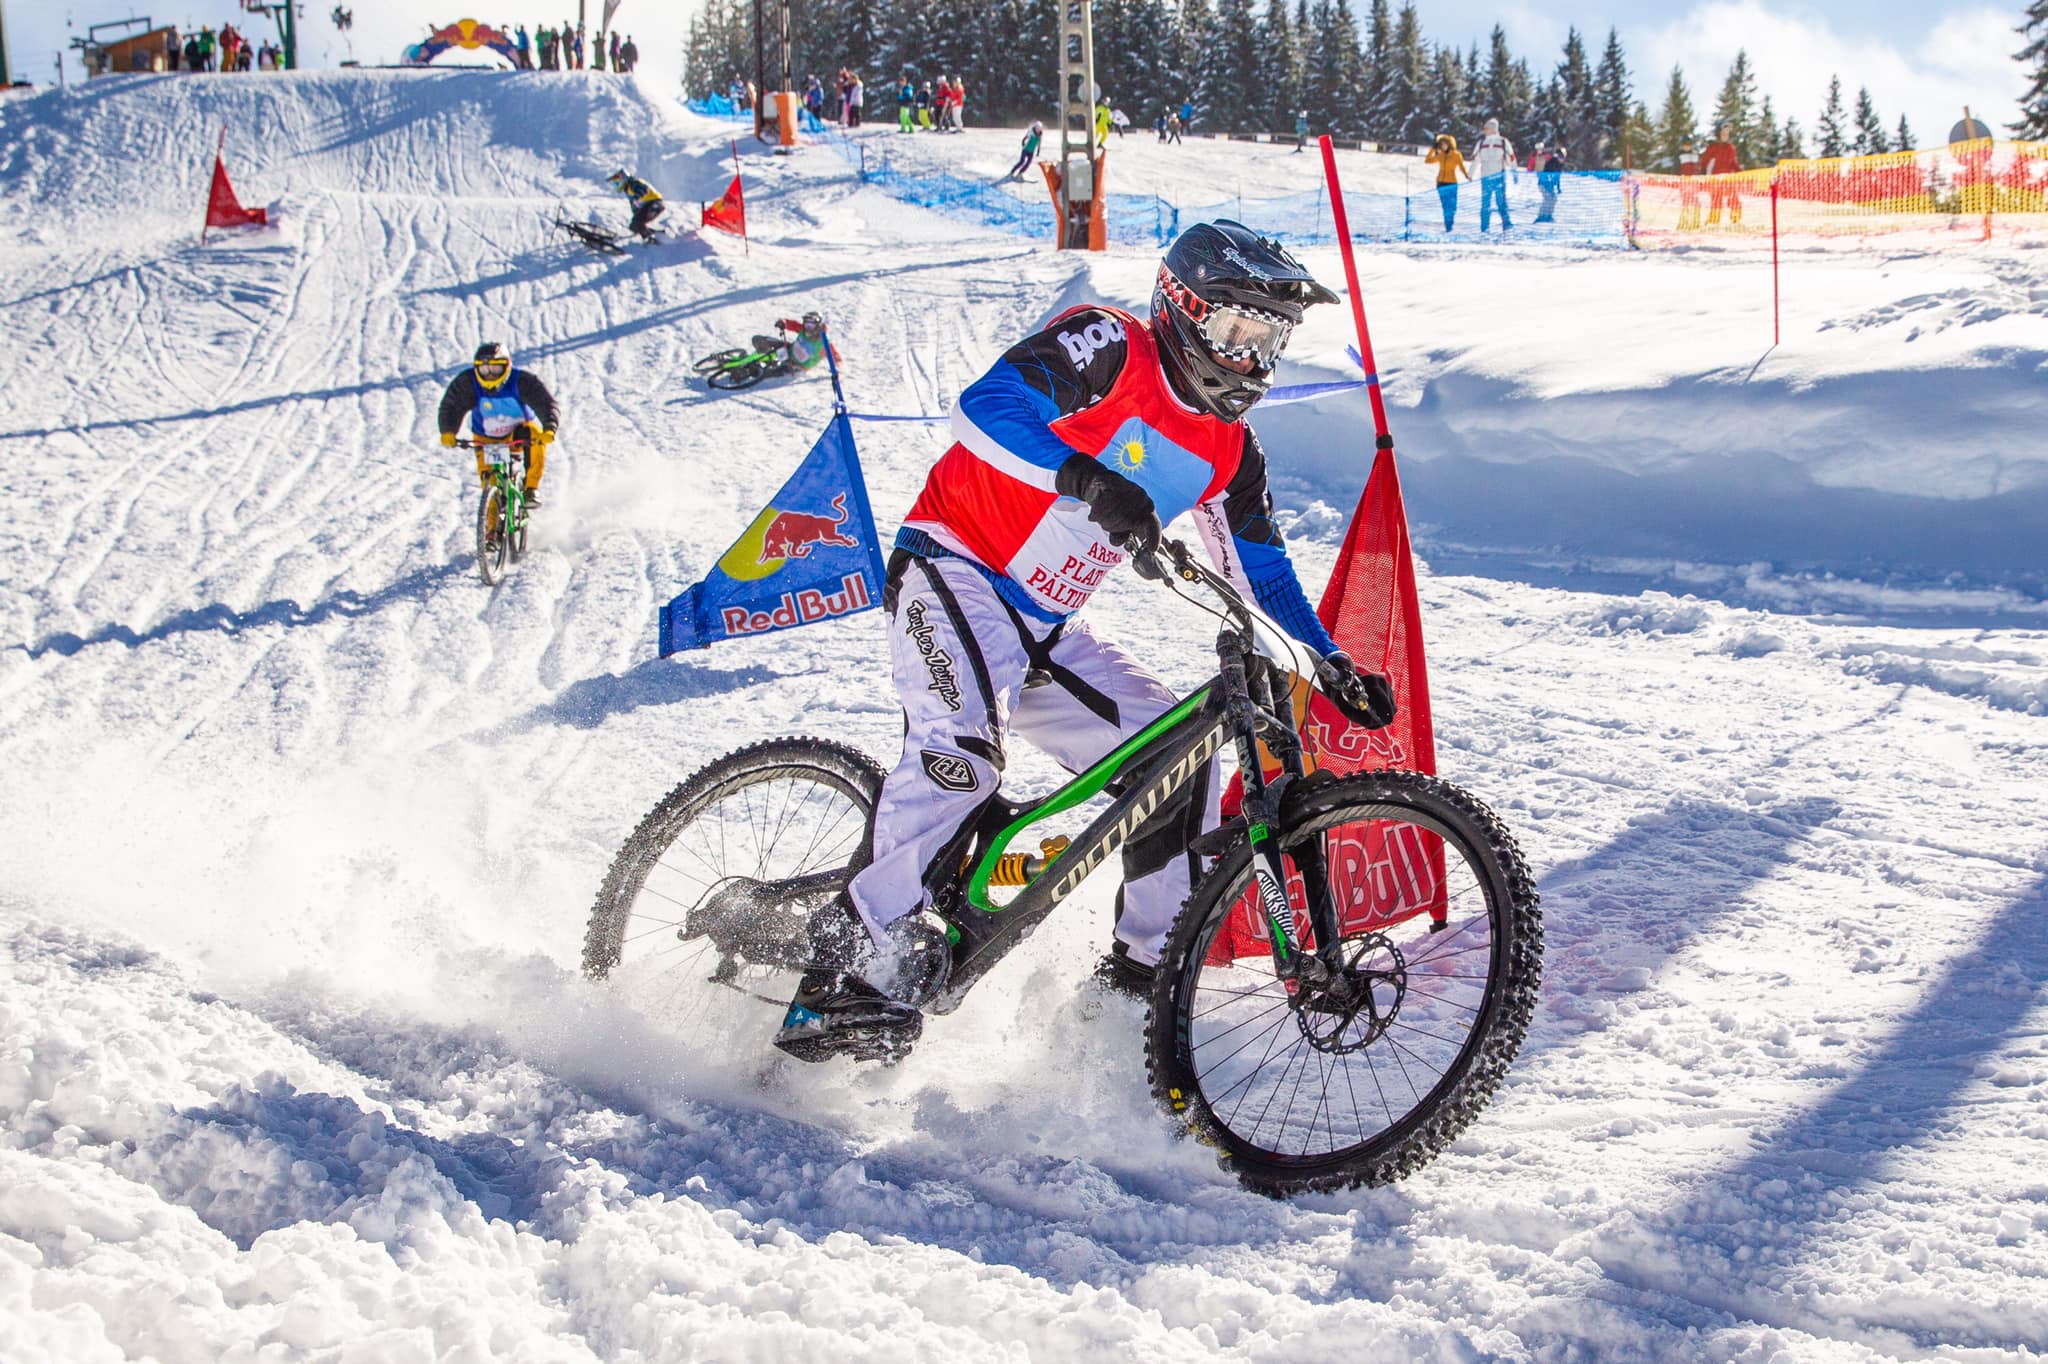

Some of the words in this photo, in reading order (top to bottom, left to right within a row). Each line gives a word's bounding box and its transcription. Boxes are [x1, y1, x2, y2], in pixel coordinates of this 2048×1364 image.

[1060, 554, 1105, 586] PLAT
[721, 592, 799, 635] Red
[797, 571, 871, 622] Bull
[1337, 822, 1436, 926] Bull
